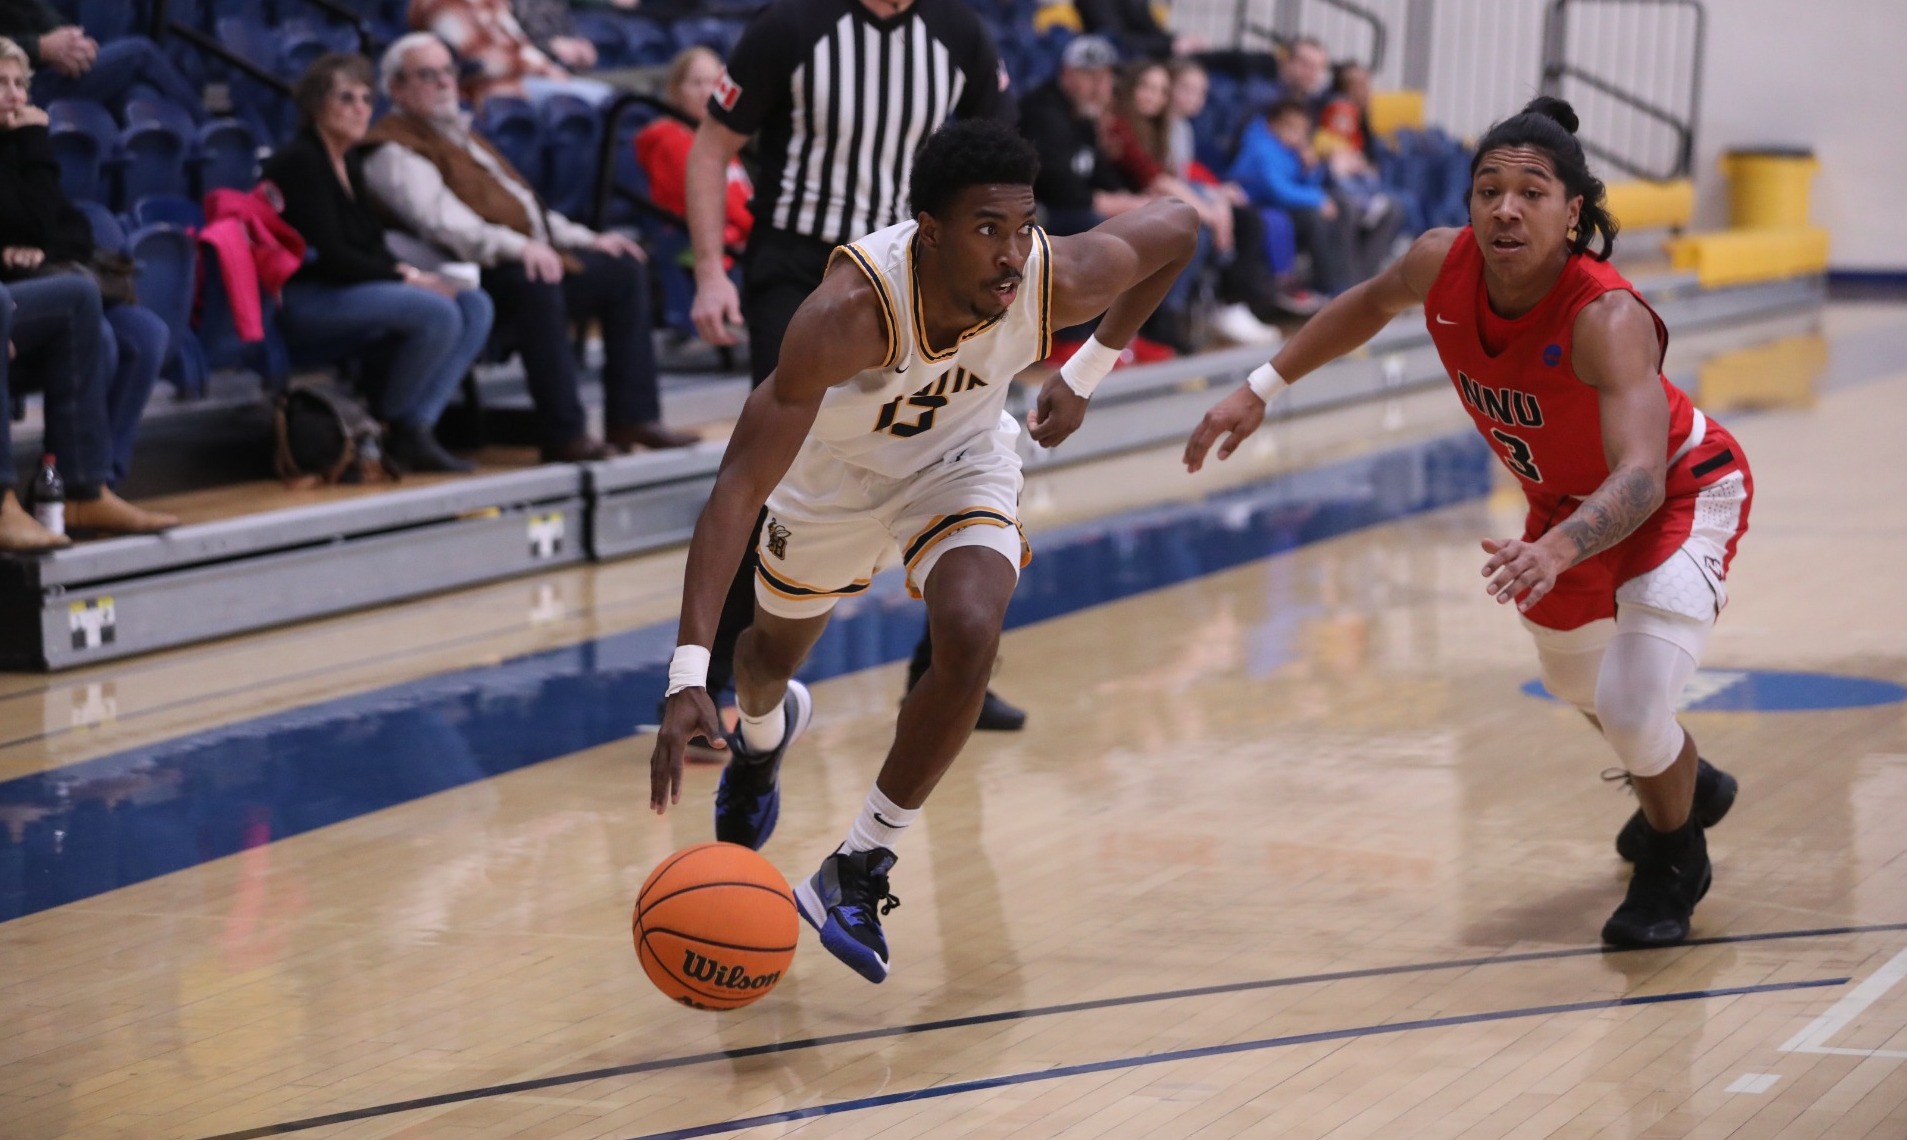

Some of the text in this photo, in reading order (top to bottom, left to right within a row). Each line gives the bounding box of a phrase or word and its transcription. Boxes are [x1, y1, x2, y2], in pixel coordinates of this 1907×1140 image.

[1458, 369, 1544, 428] NNU
[1490, 427, 1543, 484] 3
[681, 948, 781, 990] Wilson
